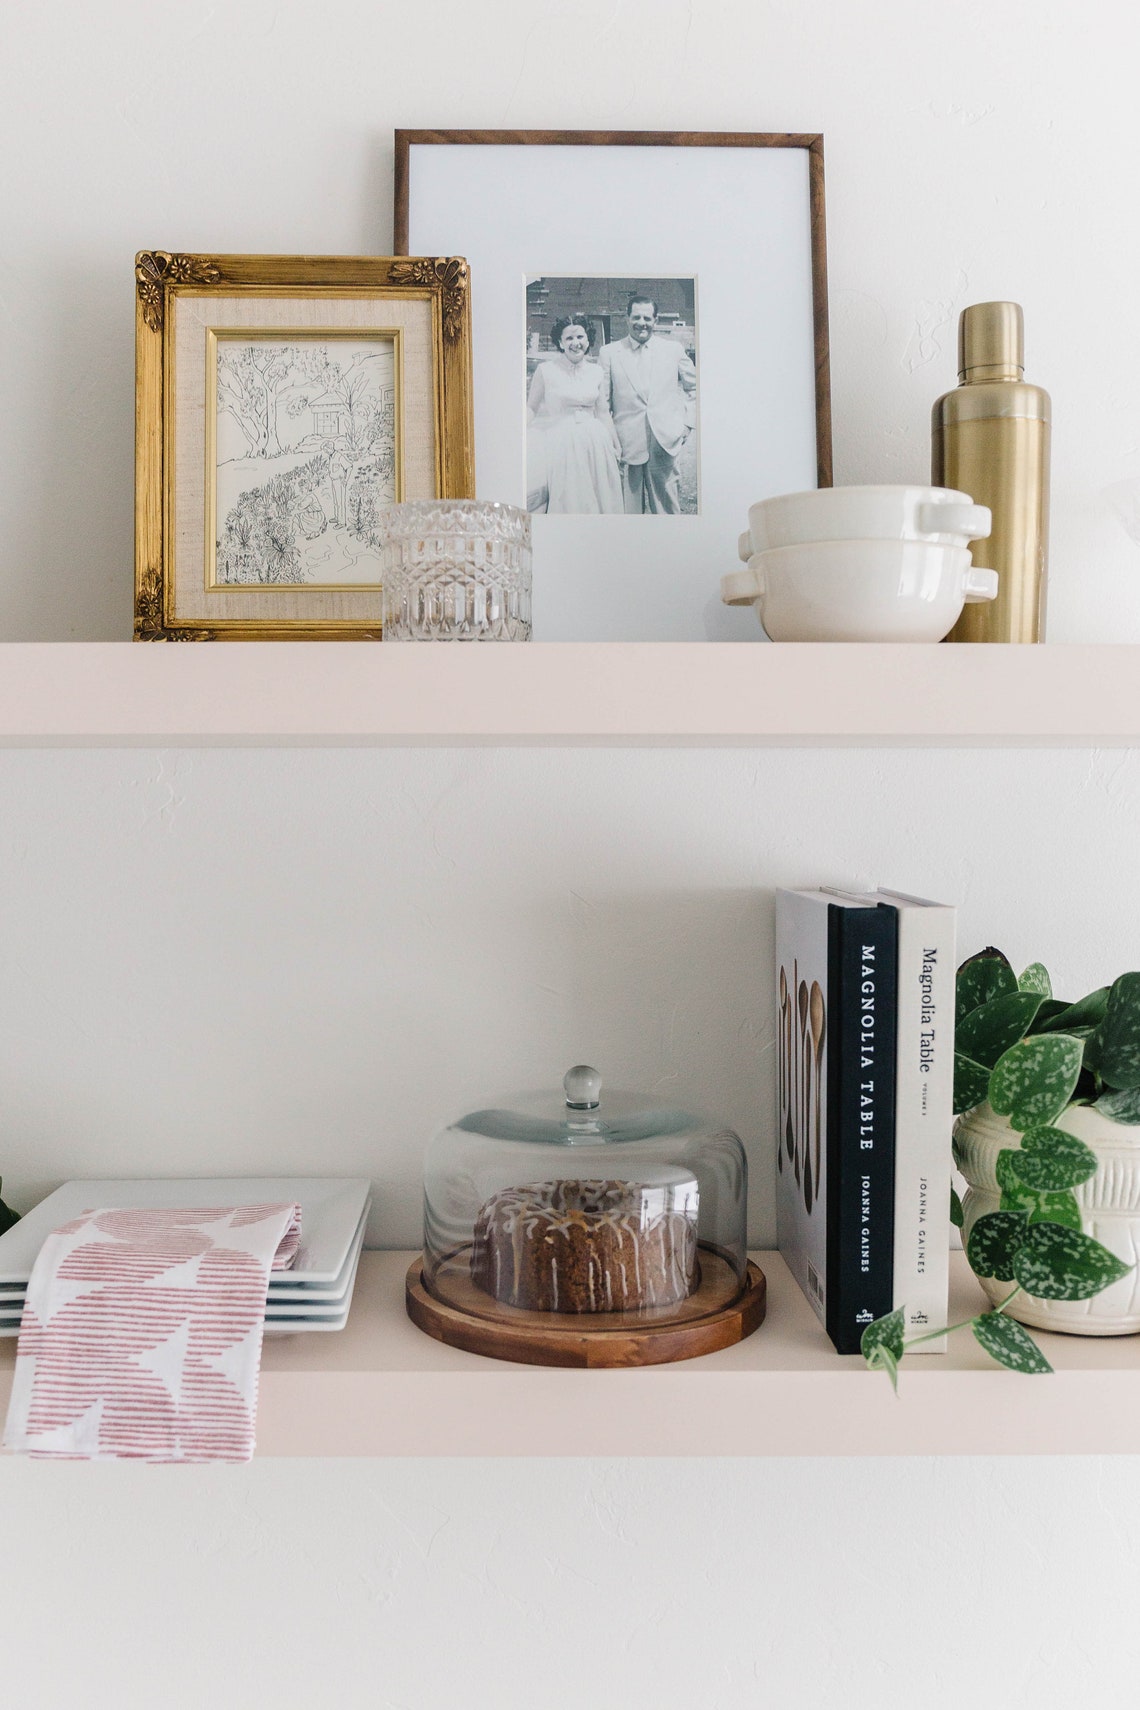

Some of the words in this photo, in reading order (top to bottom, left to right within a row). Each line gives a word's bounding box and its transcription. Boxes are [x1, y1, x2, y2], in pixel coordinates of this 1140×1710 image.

[860, 944, 876, 1069] MAGNOLIA
[918, 947, 938, 1025] Magnolia
[919, 1028, 936, 1073] Table
[859, 1080, 875, 1150] TABLE
[861, 1175, 871, 1223] JOANNA
[919, 1177, 928, 1223] JOANNA
[861, 1227, 870, 1273] GAINES
[917, 1230, 926, 1274] GAINES
